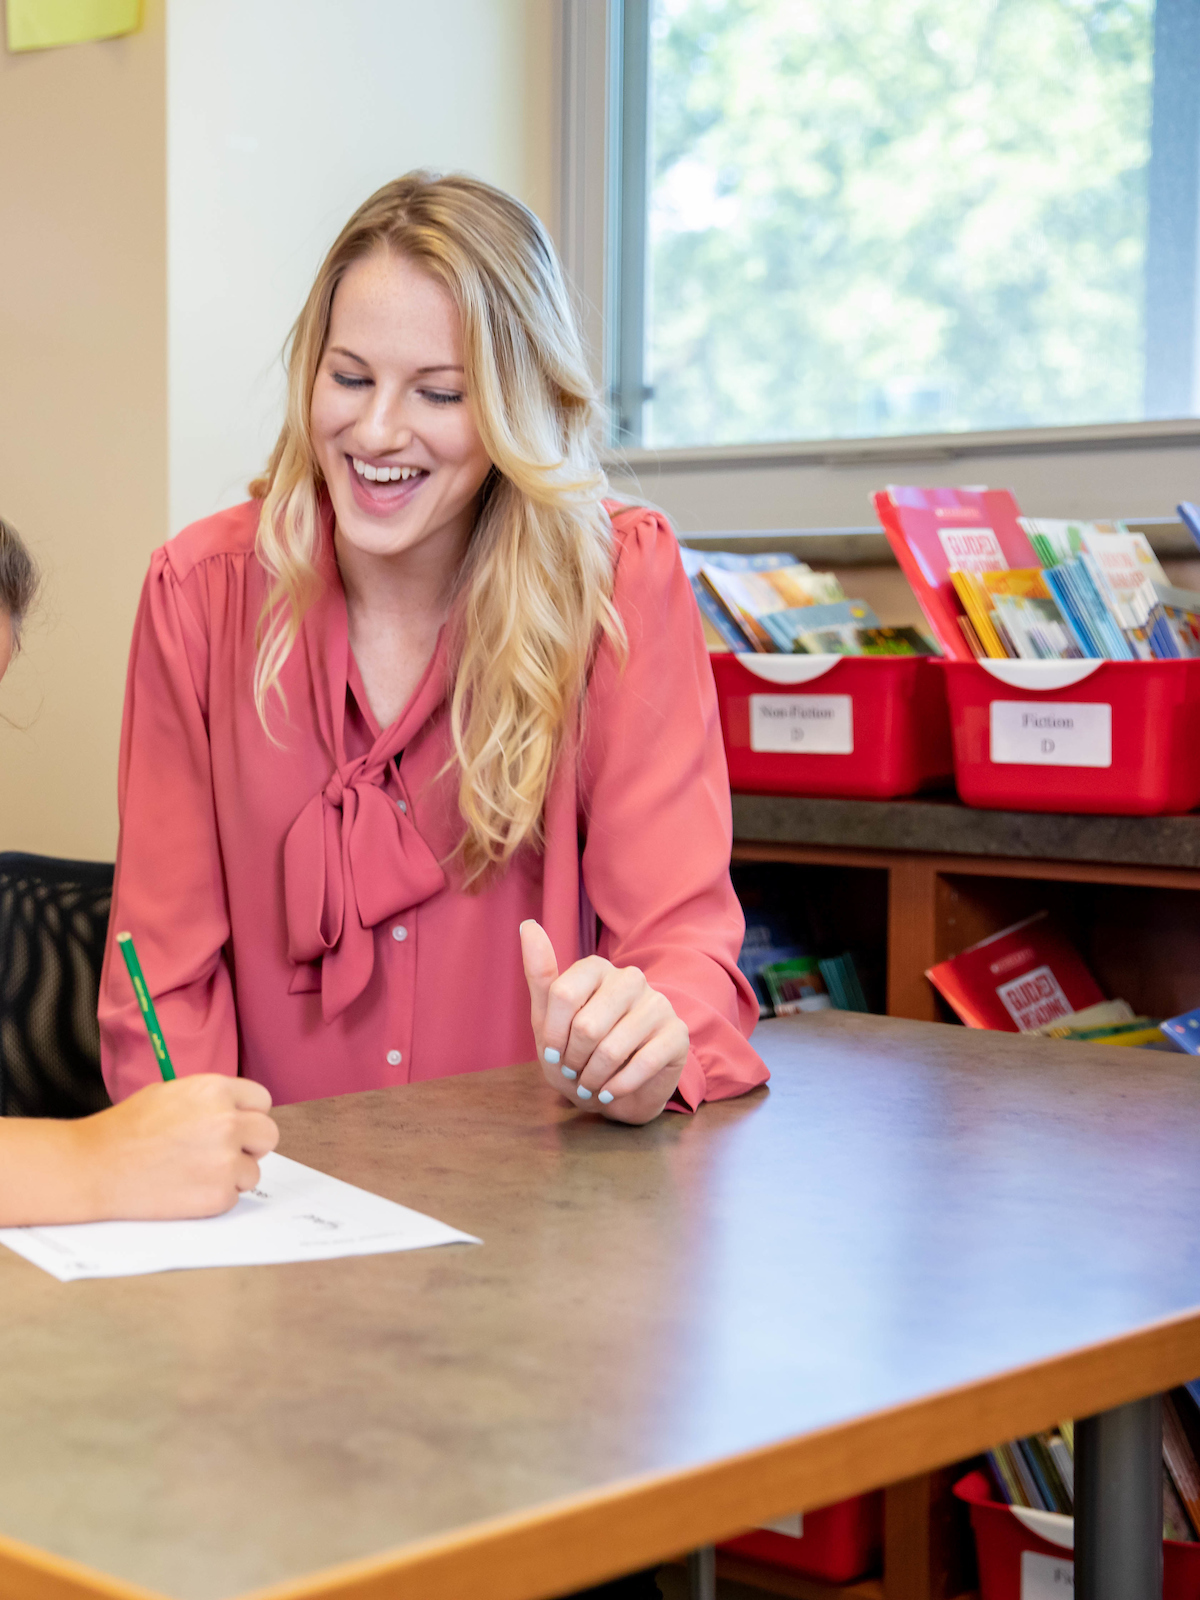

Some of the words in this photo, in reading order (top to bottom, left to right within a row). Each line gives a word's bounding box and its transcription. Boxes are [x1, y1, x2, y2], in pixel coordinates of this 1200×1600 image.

[1021, 712, 1075, 730] Fiction
[790, 727, 805, 742] D
[1040, 738, 1056, 754] D
